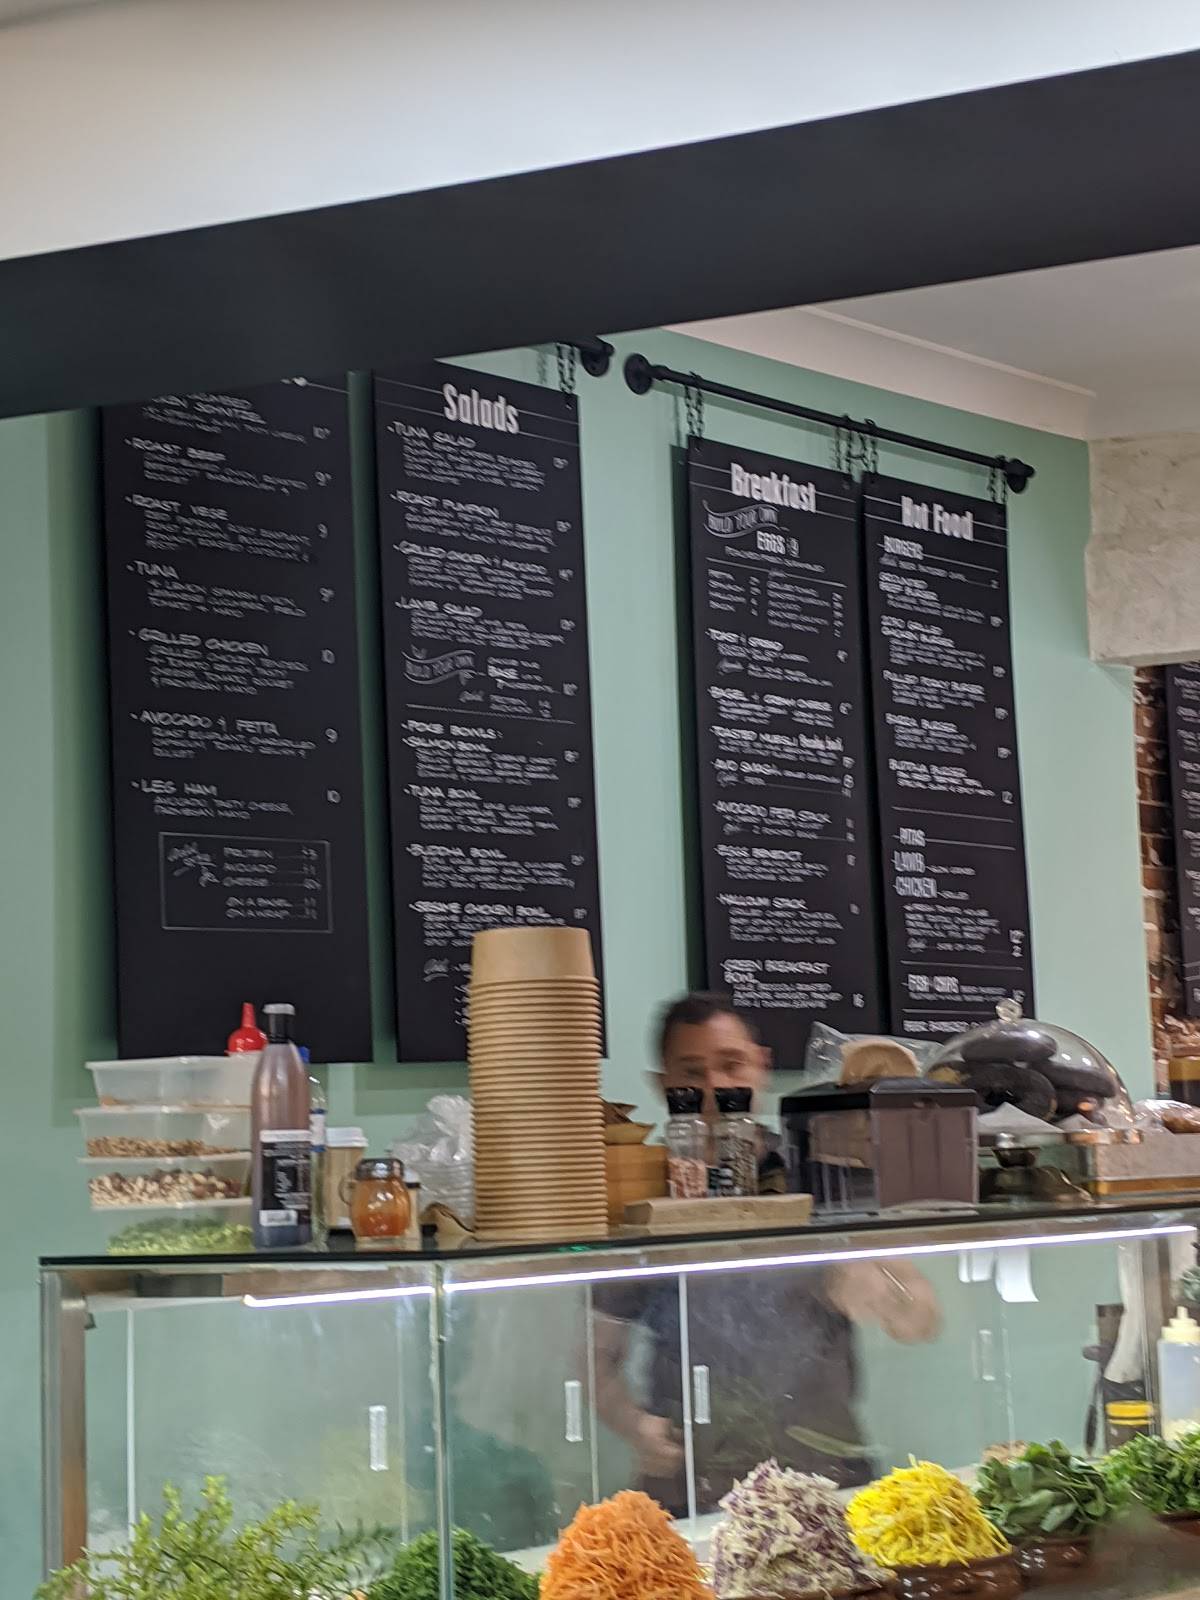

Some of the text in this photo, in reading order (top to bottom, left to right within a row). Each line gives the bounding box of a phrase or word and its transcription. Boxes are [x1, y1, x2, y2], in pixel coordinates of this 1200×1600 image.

[442, 383, 521, 434] Salads
[394, 421, 431, 440] TUNA
[731, 463, 817, 514] Breakfast
[131, 494, 181, 512] ROAST
[901, 496, 974, 542] Hot Food
[133, 559, 180, 579] TUNA
[139, 710, 213, 729] AVOCADO
[183, 782, 218, 796] HAM
